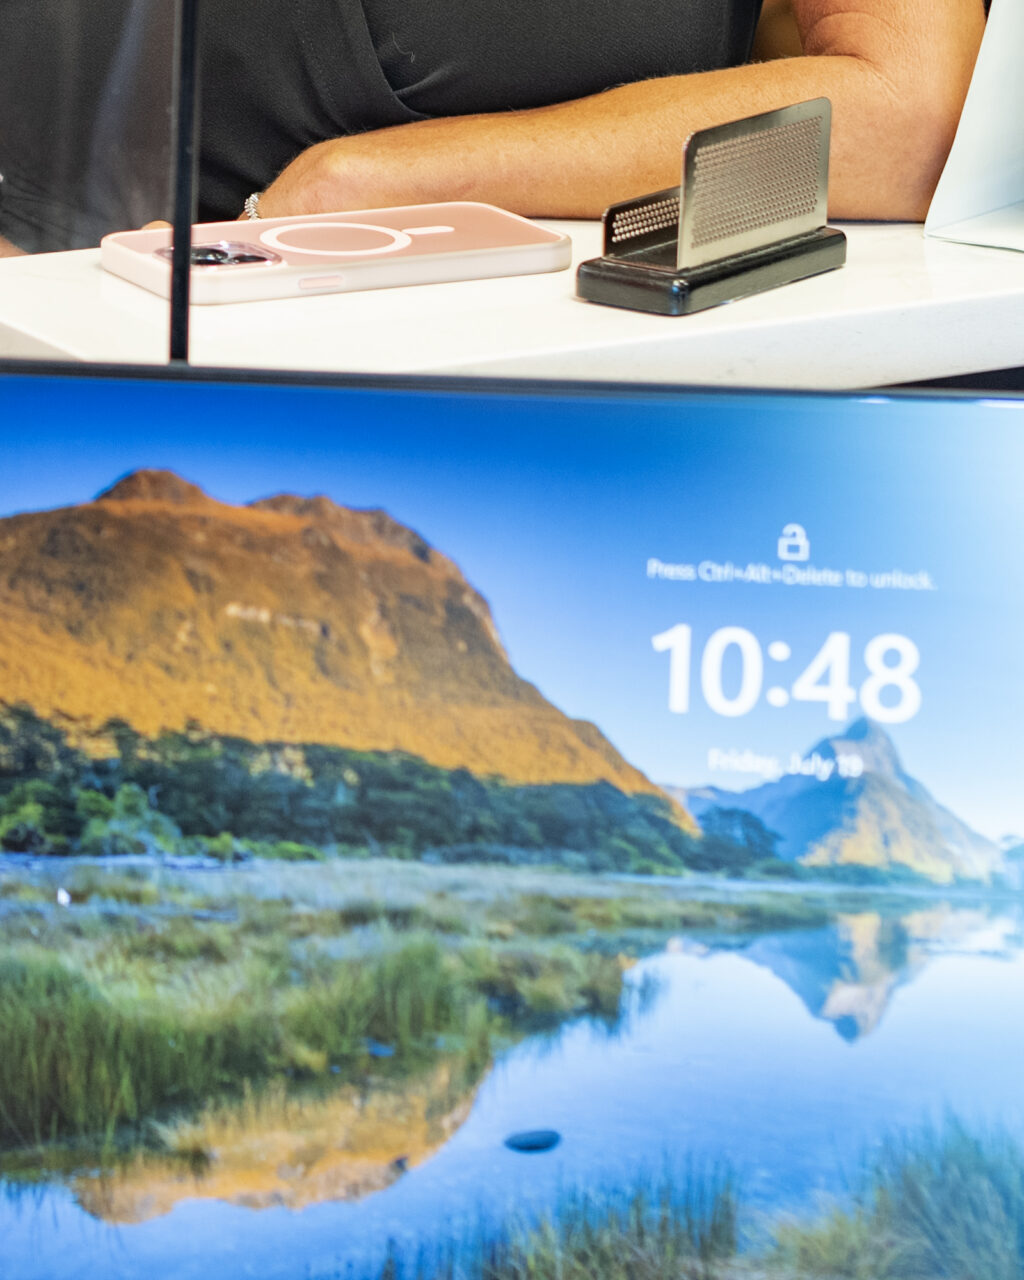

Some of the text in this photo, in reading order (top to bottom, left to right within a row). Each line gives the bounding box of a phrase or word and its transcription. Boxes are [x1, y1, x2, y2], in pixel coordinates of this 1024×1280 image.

[646, 558, 696, 581] Press
[845, 568, 867, 588] to
[651, 623, 921, 723] 10:48
[788, 751, 834, 781] July
